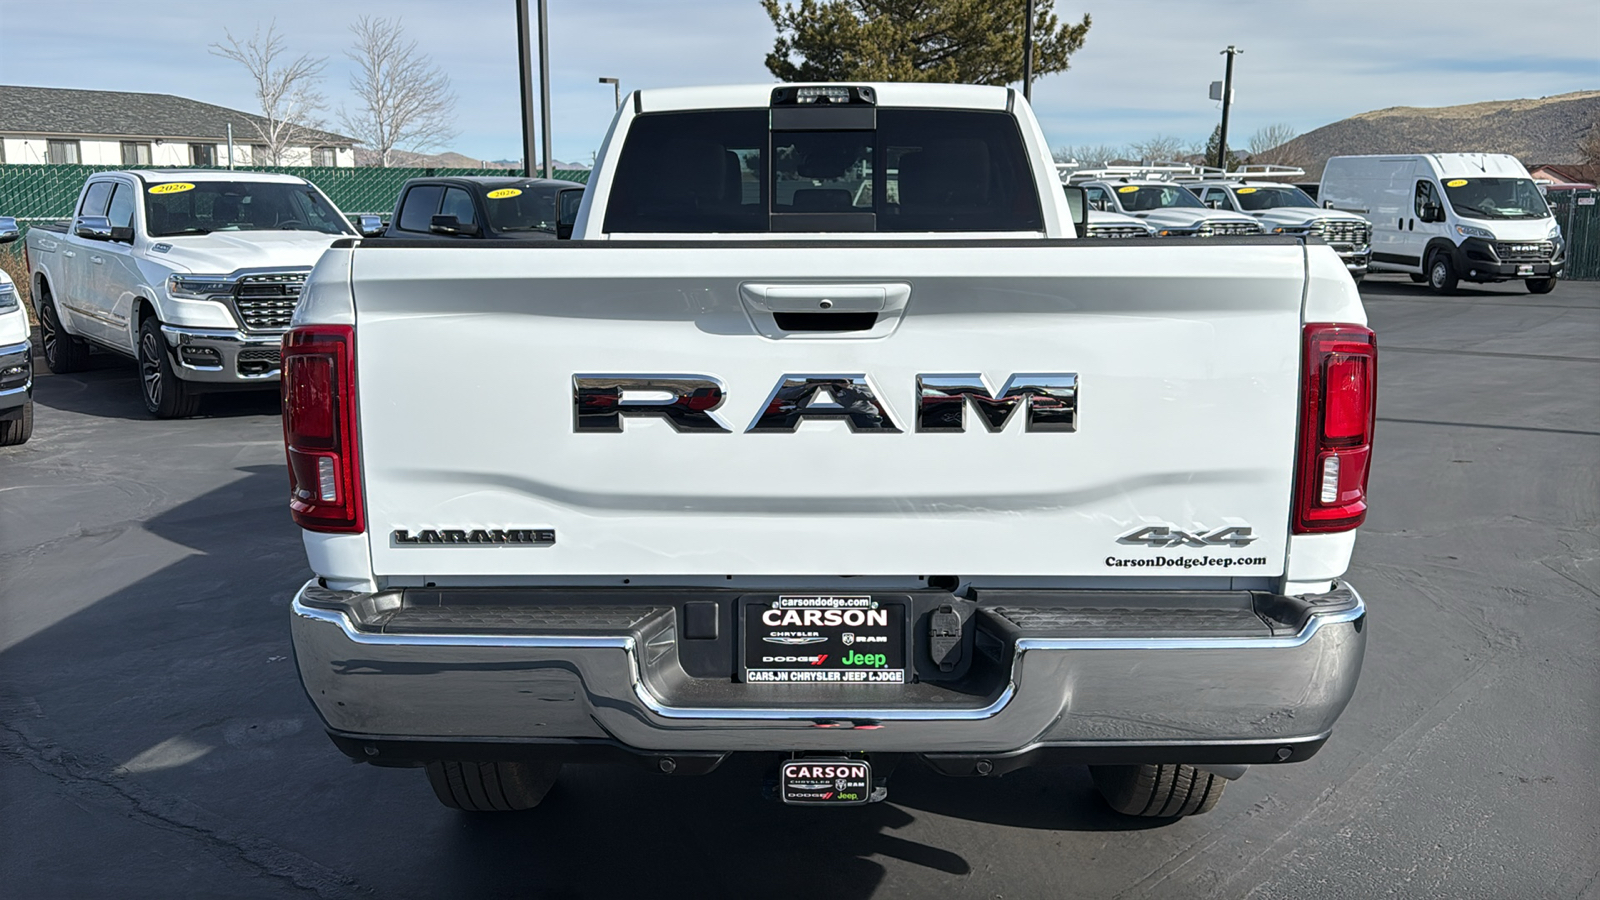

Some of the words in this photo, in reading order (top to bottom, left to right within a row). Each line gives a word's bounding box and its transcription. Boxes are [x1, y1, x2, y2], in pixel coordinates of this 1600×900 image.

[158, 184, 187, 193] 2026
[495, 190, 516, 198] 2026
[571, 372, 1080, 434] RAM
[389, 529, 556, 549] LARAMIE
[1105, 556, 1267, 569] CarsonDodgeJeep.com
[781, 597, 869, 608] carsondodge.com
[762, 609, 888, 627] CARSON
[841, 650, 887, 668] Jeep
[790, 671, 841, 681] CHRYSLER
[842, 671, 867, 681] JEEP
[786, 766, 865, 778] CARSON
[837, 792, 858, 800] Jeep
